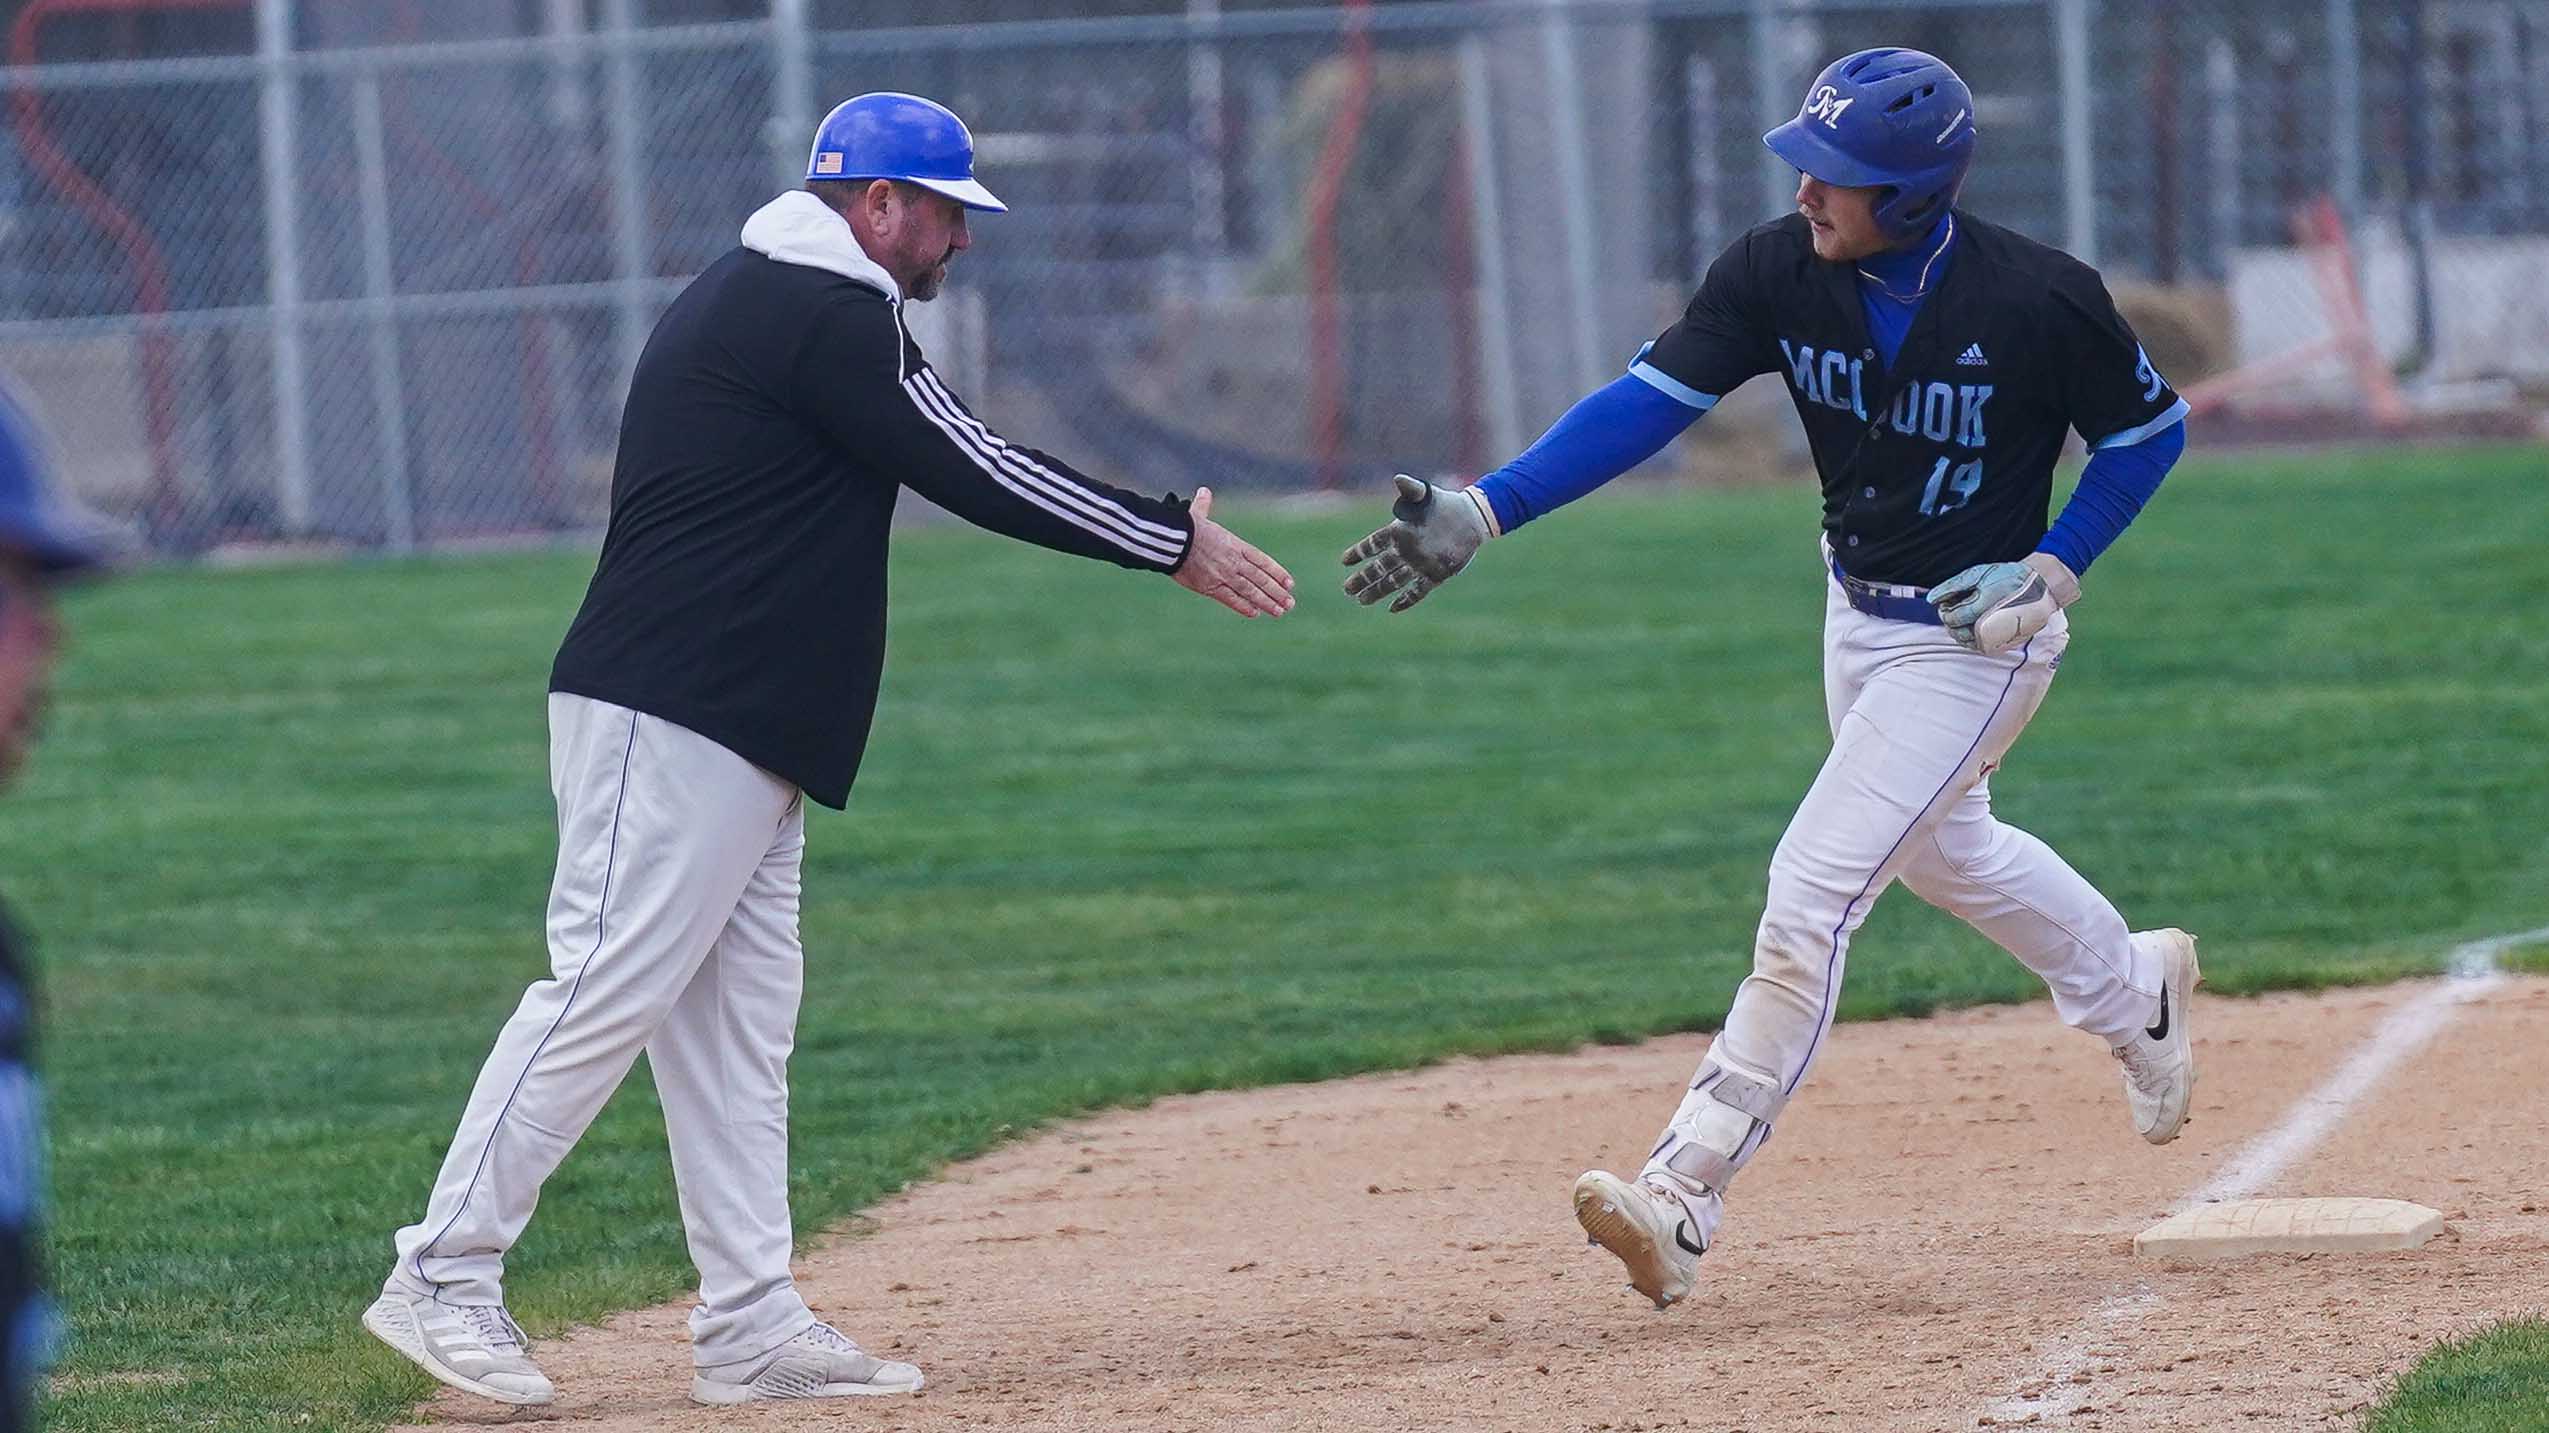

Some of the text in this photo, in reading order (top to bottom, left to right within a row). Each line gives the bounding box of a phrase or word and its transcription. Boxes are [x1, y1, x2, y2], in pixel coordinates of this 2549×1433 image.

[1807, 85, 1854, 130] M
[1955, 357, 1989, 367] adidas
[1918, 455, 1983, 516] 19
